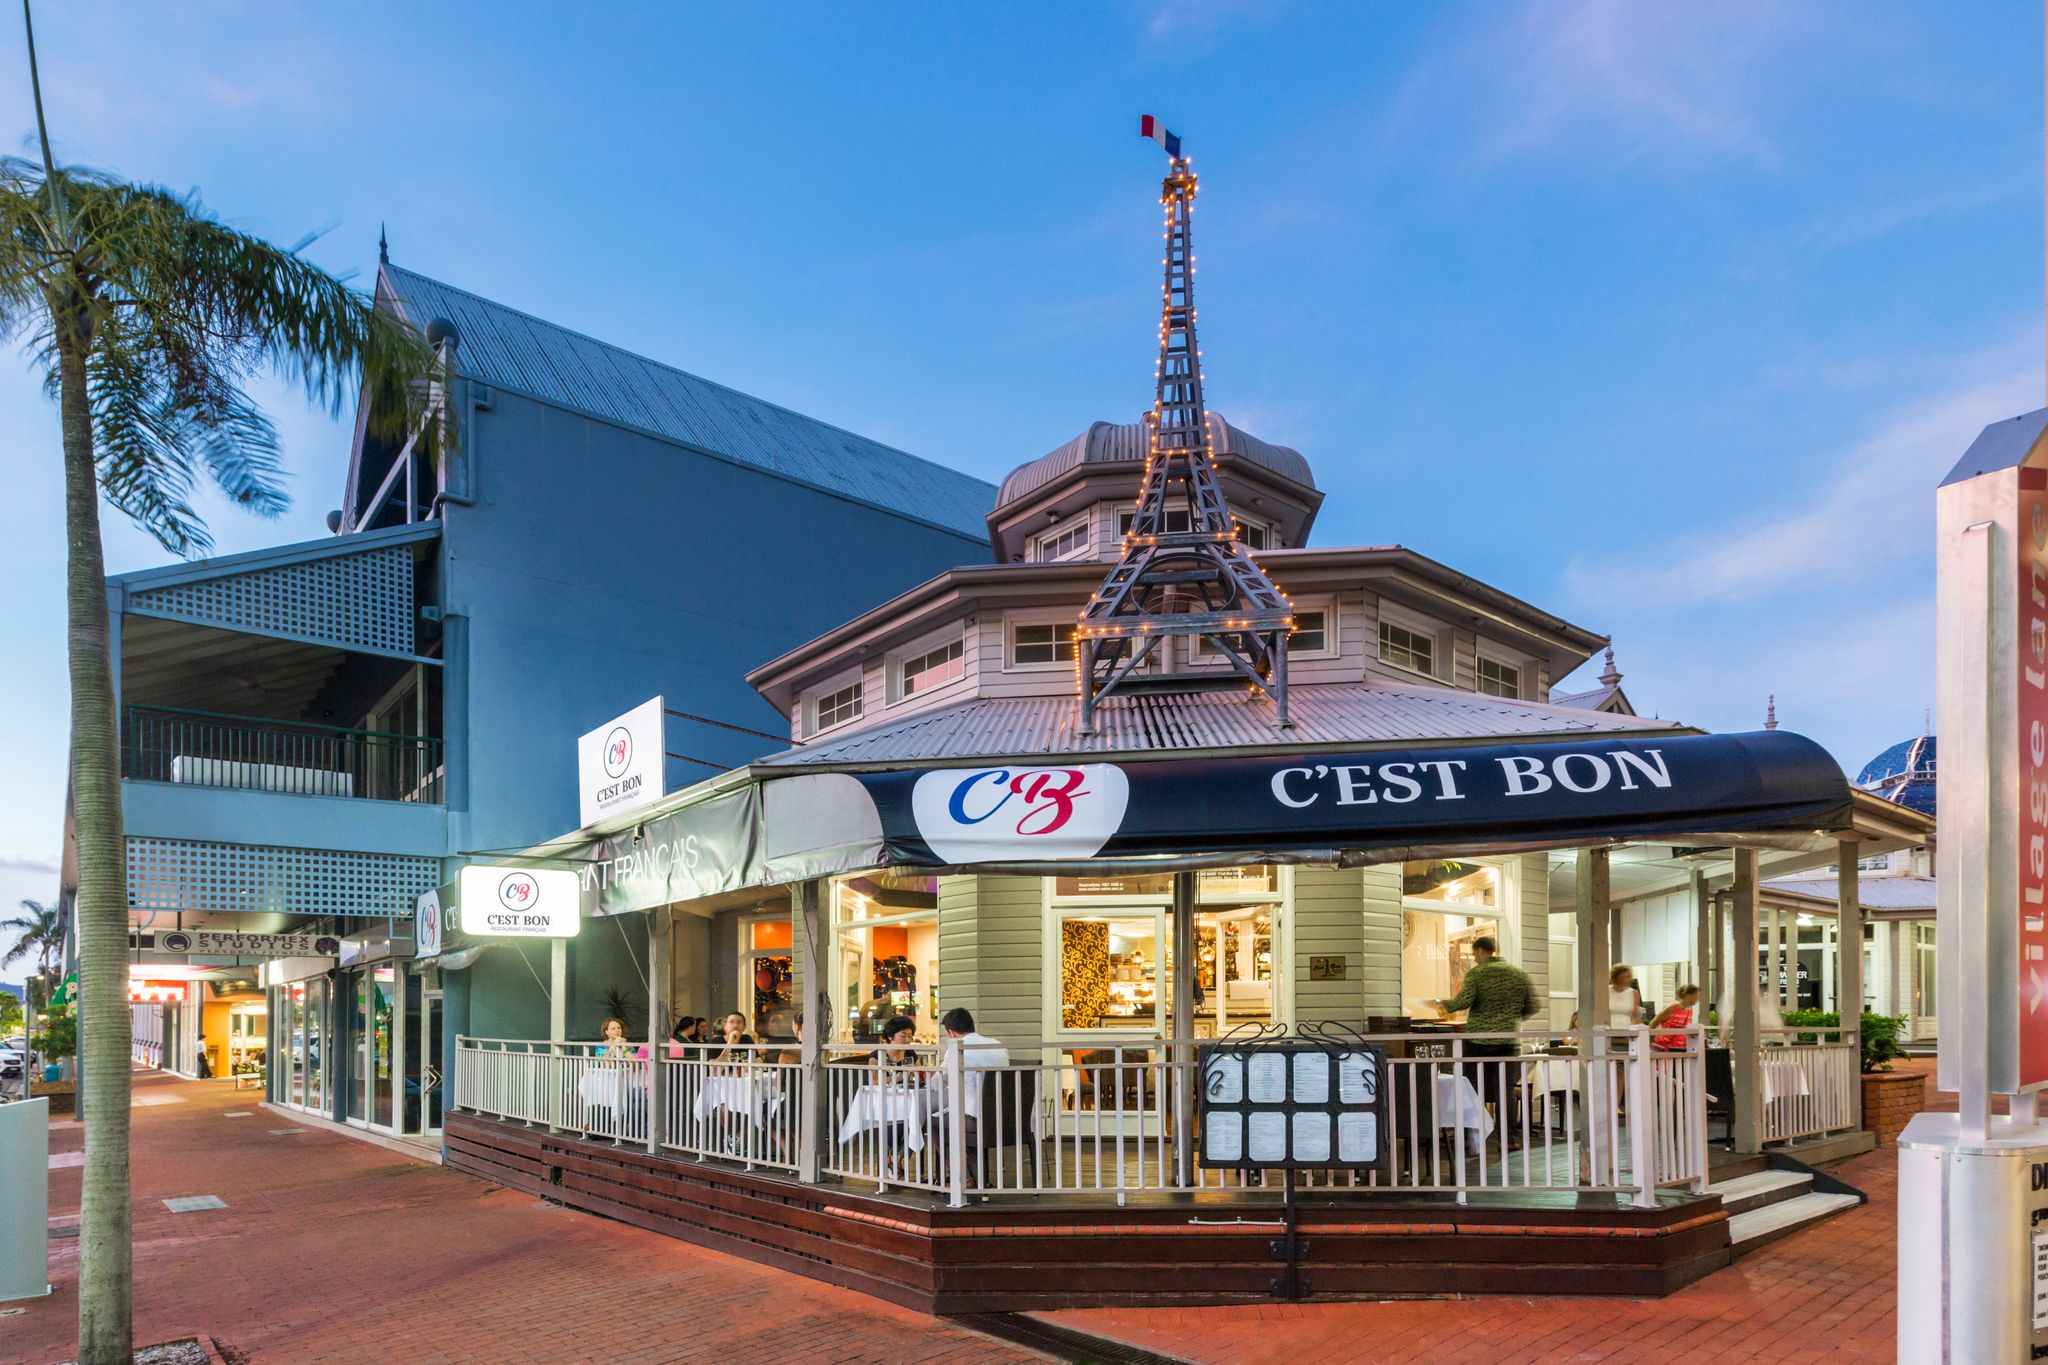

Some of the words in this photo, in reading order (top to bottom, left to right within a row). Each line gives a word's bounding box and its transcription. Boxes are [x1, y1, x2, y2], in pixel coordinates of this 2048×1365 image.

[2025, 502, 2047, 690] lane
[608, 739, 627, 765] CB
[597, 783, 620, 802] C'EST
[622, 773, 642, 793] BON
[1271, 760, 1467, 808] C'EST
[1494, 749, 1673, 796] BON
[948, 769, 1091, 836] CB
[2025, 719, 2048, 1017] village
[506, 883, 531, 902] CB
[421, 904, 437, 947] CB
[487, 914, 520, 926] C'EST
[523, 915, 551, 926] BON
[198, 940, 309, 950] STUDIOS
[199, 933, 309, 943] PERFORMEX
